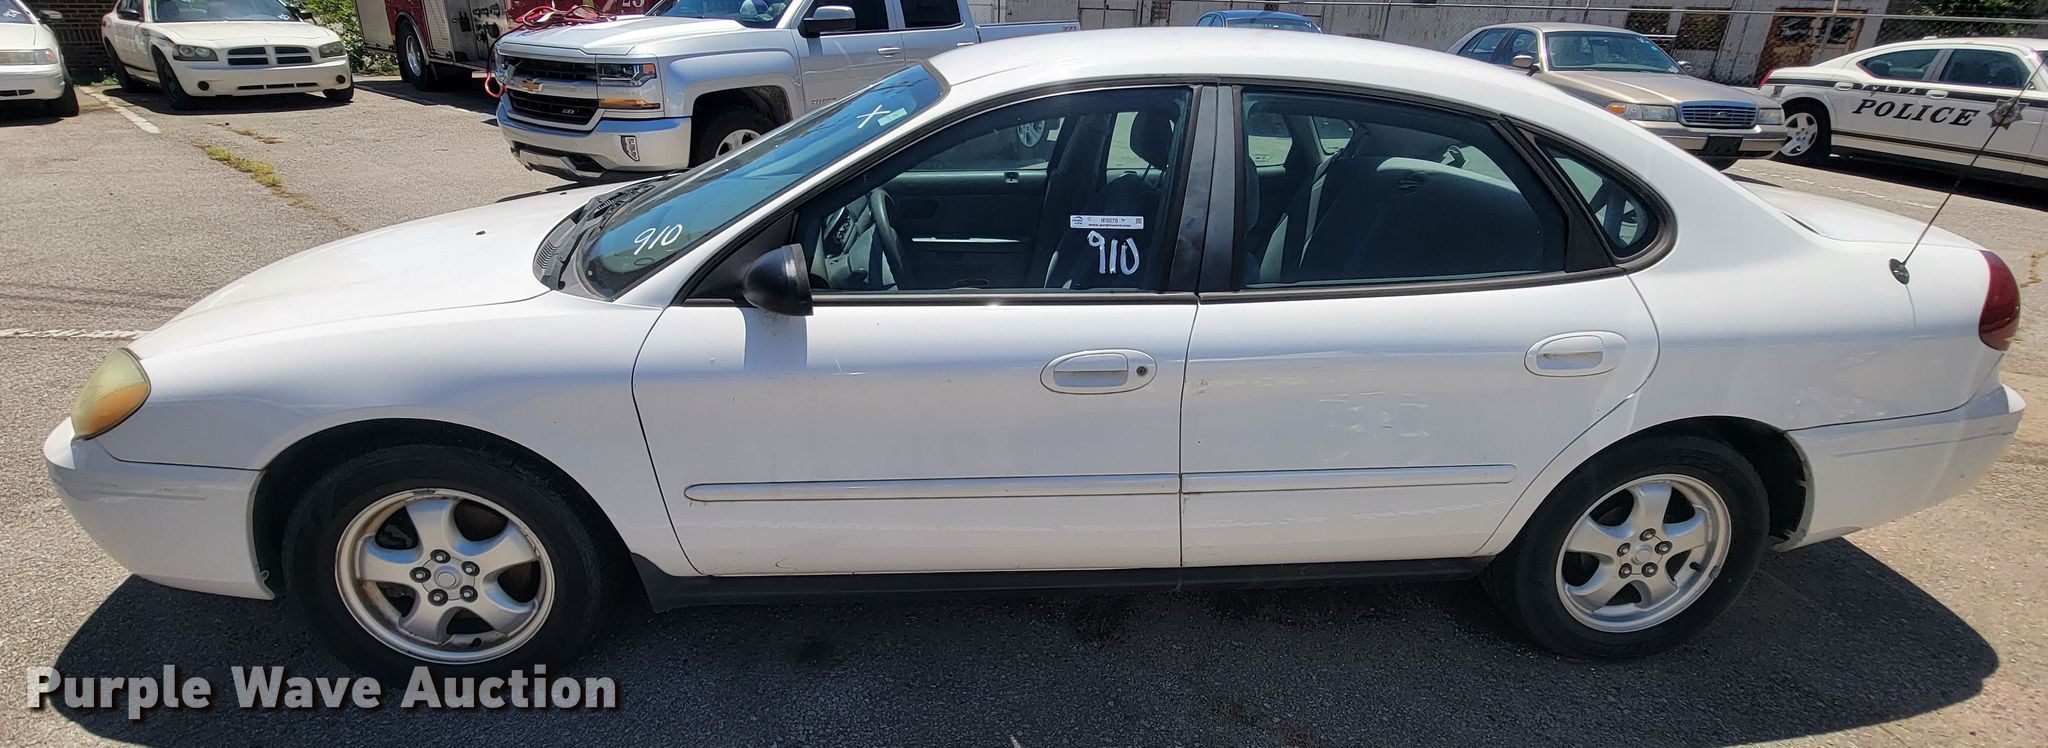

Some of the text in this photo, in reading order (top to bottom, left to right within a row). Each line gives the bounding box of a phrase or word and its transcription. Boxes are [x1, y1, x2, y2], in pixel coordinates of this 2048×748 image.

[1852, 99, 1980, 126] POLICE
[633, 223, 683, 255] 910
[1087, 230, 1140, 275] 910
